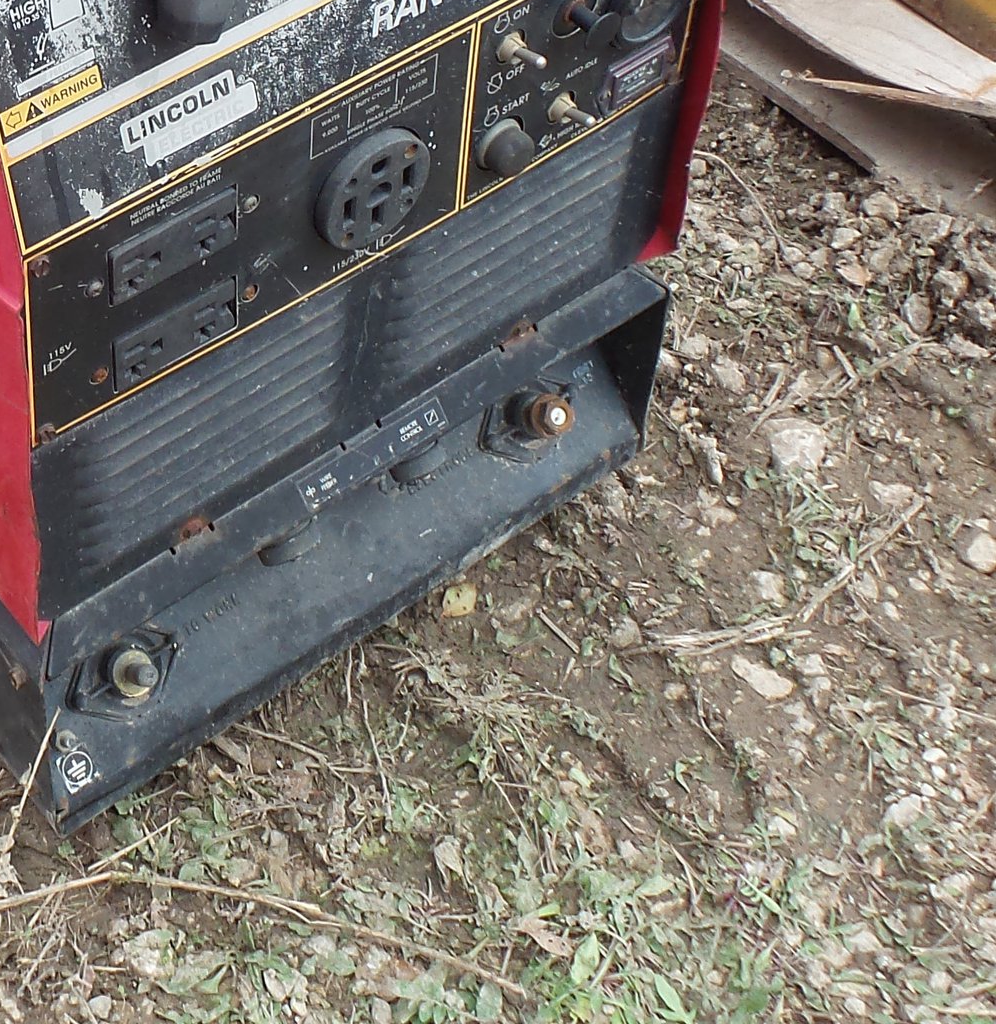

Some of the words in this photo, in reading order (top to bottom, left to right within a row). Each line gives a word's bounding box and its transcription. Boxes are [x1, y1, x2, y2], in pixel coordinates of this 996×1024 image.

[21, 15, 30, 26] TO
[513, 4, 530, 19] ON
[408, 68, 426, 81] VOLTS
[505, 65, 526, 81] OFF
[565, 66, 584, 81] AUTO
[40, 74, 98, 109] WARNING
[342, 84, 373, 107] AUXILIARY
[374, 73, 397, 90] POWER
[397, 61, 419, 77] RATING
[356, 96, 371, 109] DUTY
[371, 86, 391, 101] CYCLE
[501, 92, 531, 115] START
[126, 78, 230, 145] LINCOLN
[321, 113, 340, 127] WATTS
[130, 201, 159, 220] NEUTRAL
[188, 179, 200, 192] TO
[48, 342, 73, 360] 115V
